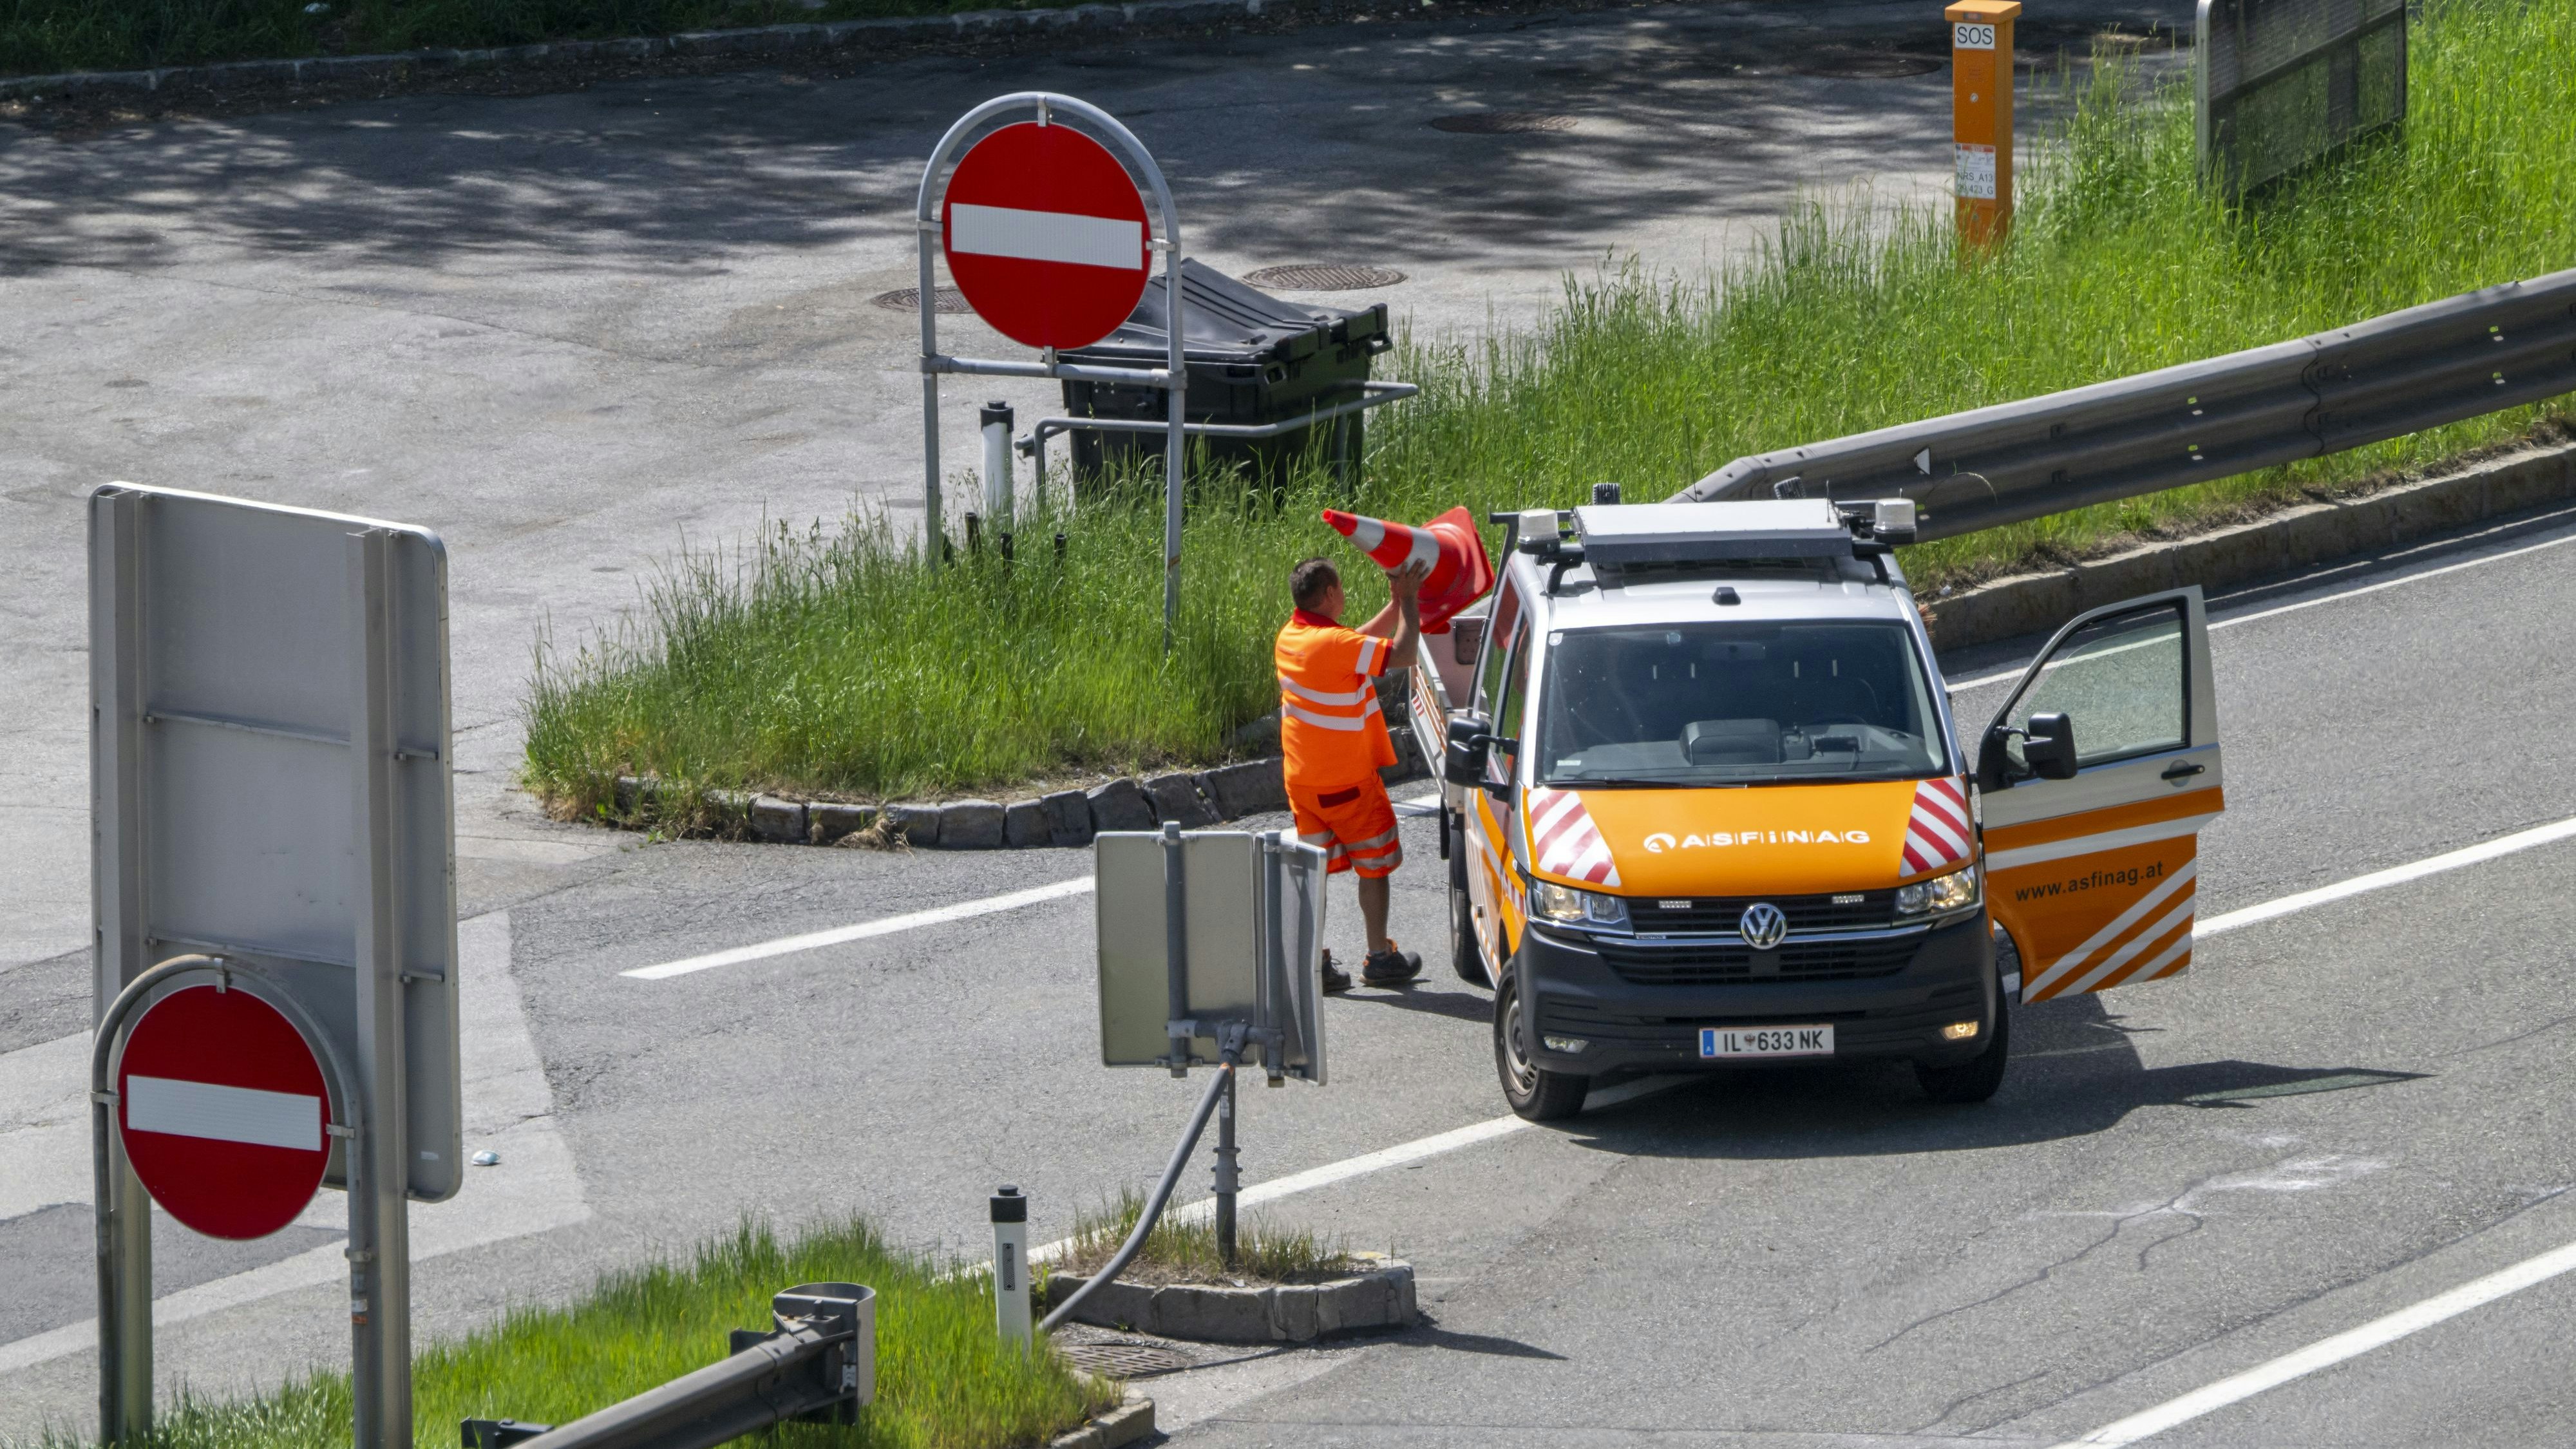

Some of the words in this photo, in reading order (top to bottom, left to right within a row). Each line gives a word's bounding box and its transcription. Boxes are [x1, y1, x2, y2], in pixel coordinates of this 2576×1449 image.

[1957, 26, 1993, 45] SOS
[2015, 860, 2163, 902] www.asfinag.at
[1724, 1032, 1741, 1052] IL
[1757, 1031, 1794, 1050] 633
[1799, 1030, 1823, 1049] NK
